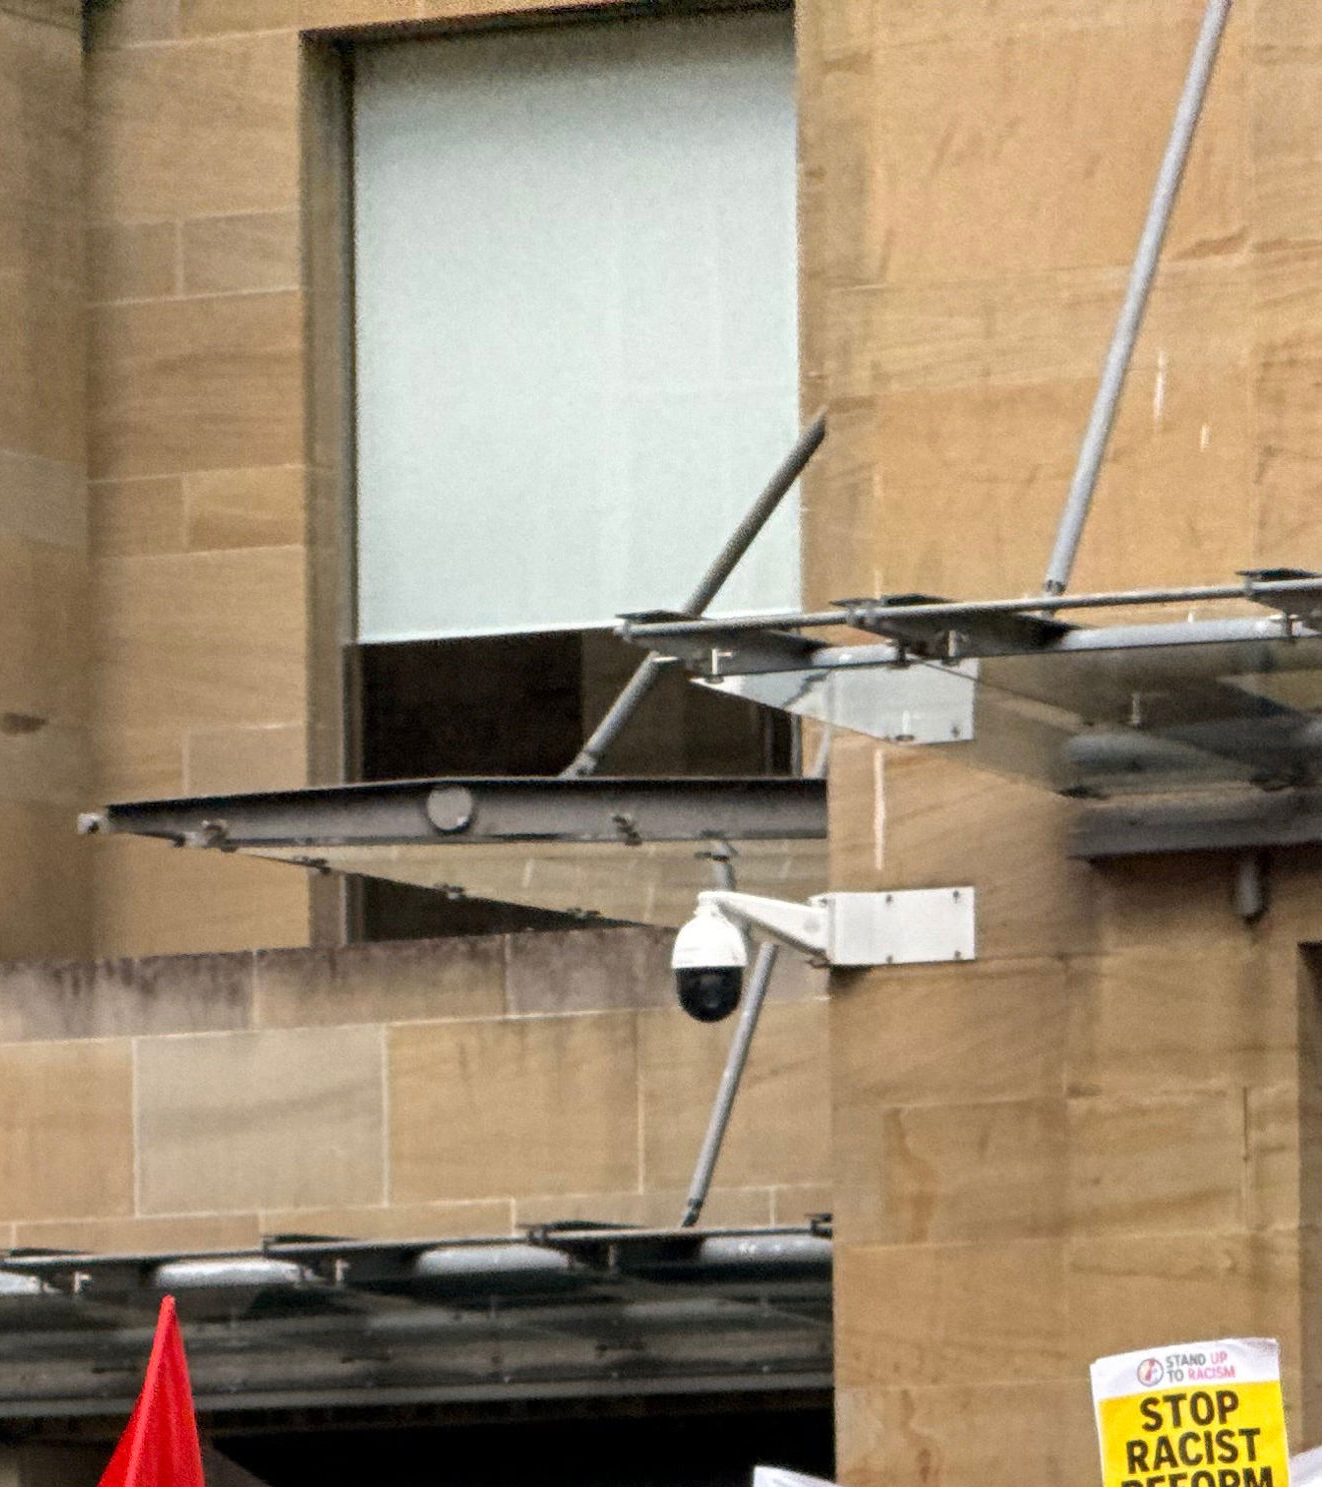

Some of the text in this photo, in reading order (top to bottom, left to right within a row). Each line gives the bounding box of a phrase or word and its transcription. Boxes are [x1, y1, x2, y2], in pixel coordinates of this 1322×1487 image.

[1166, 1351, 1229, 1368] STAND UP
[1168, 1364, 1236, 1382] TO RACISM
[1140, 1390, 1241, 1432] STOP
[1125, 1427, 1262, 1474] RACIST
